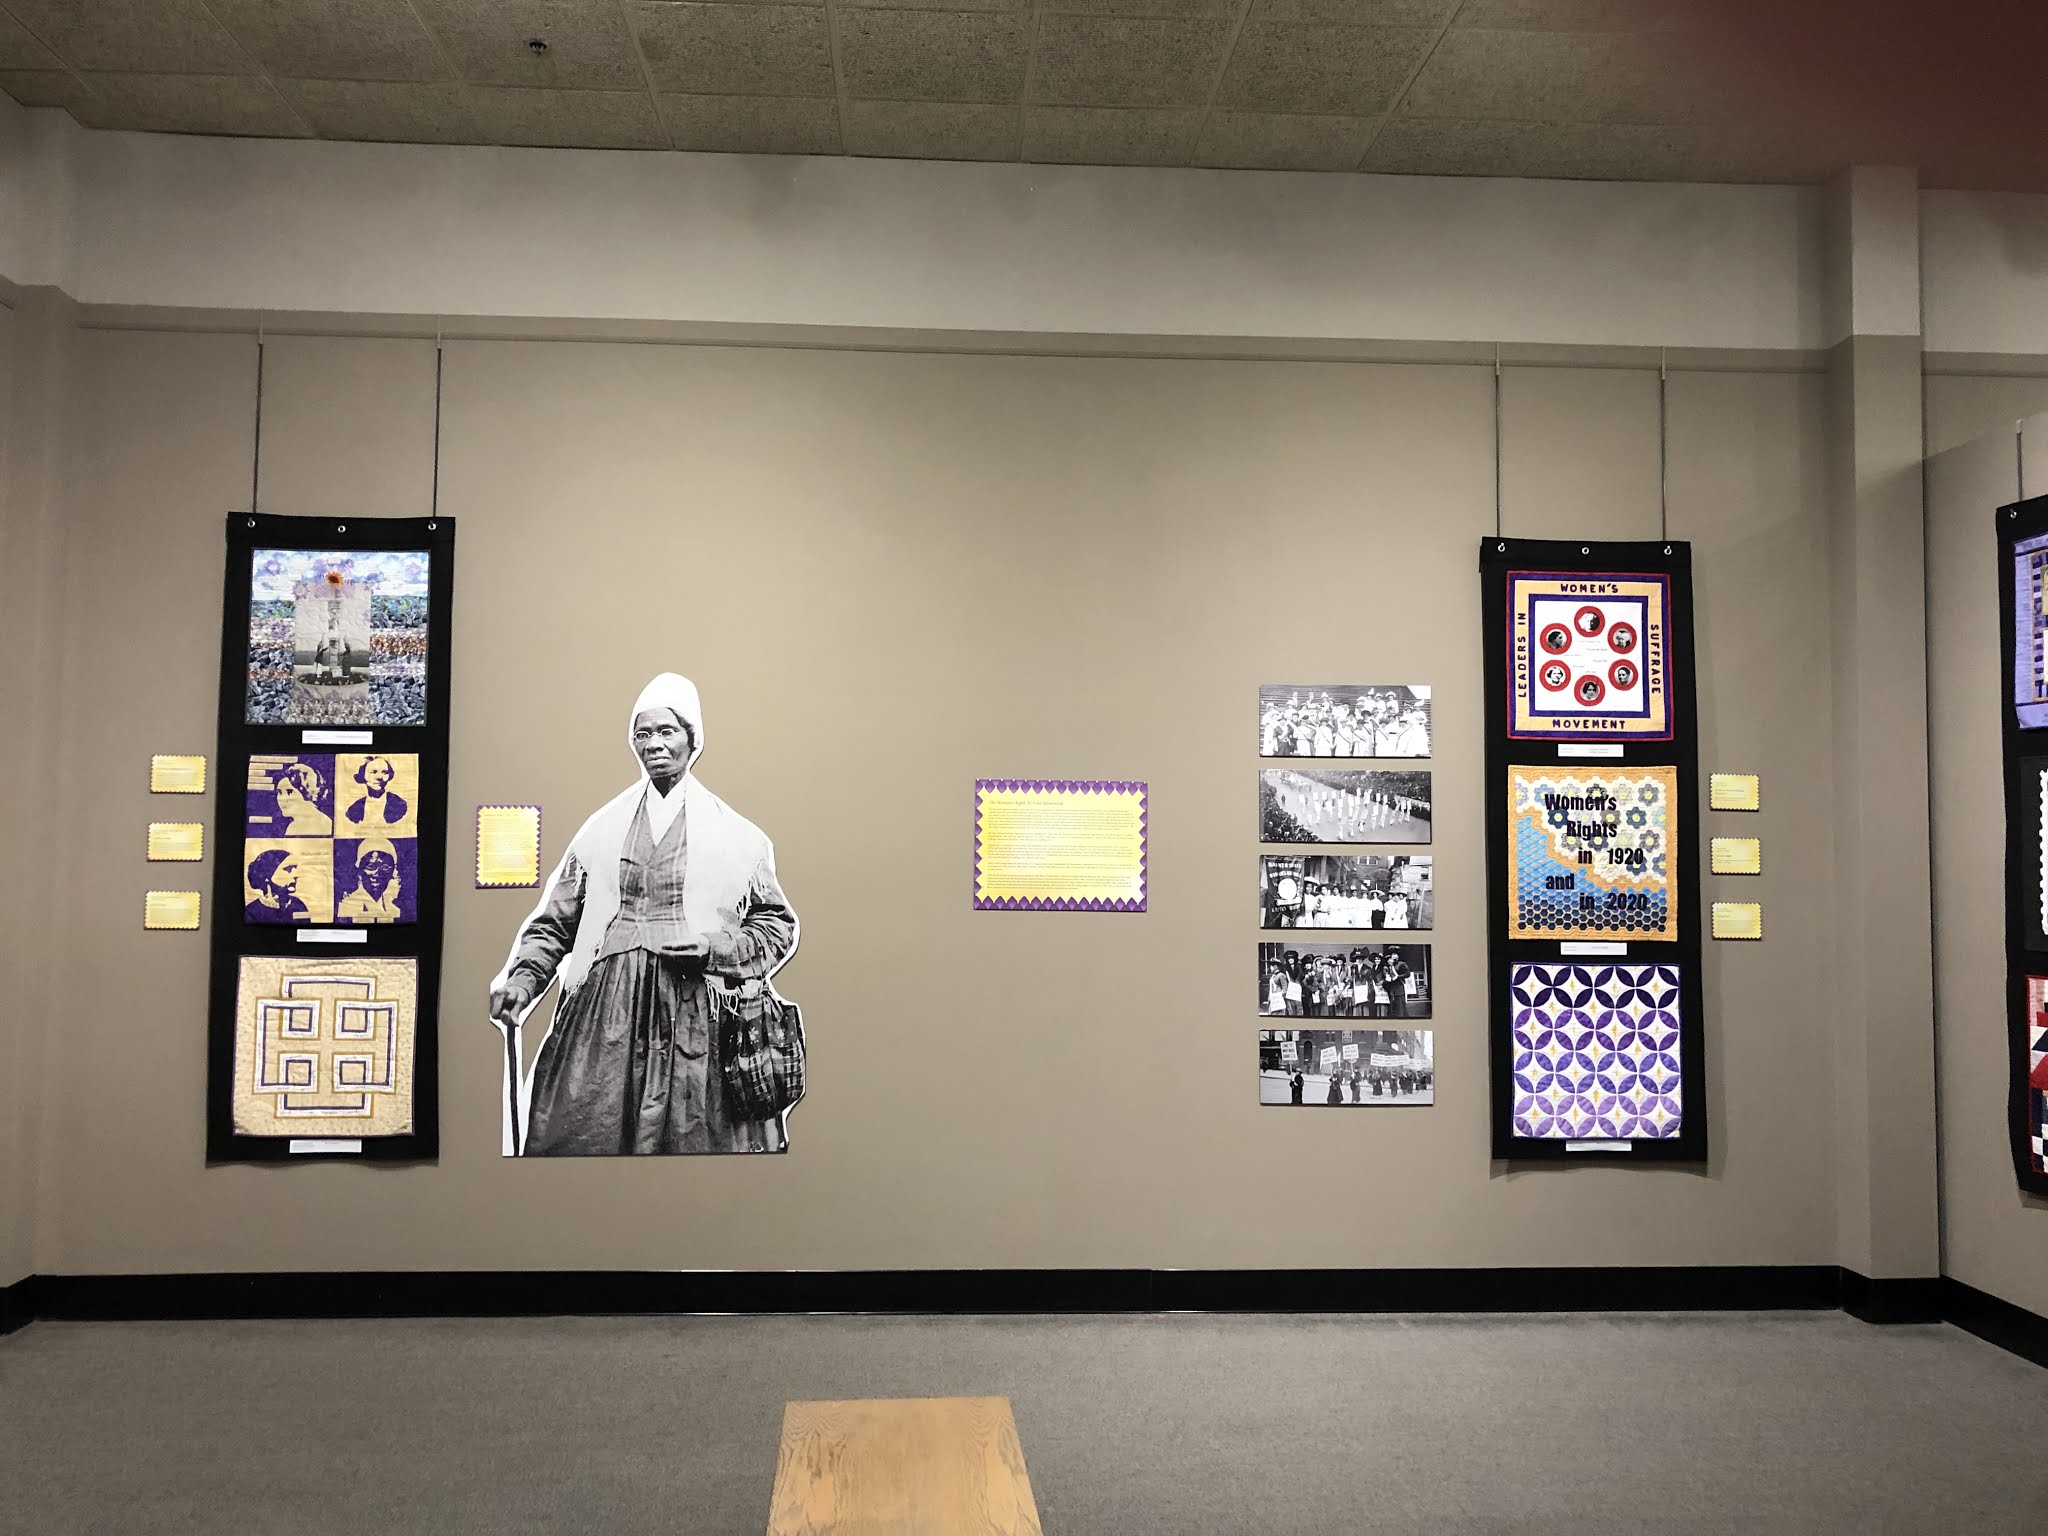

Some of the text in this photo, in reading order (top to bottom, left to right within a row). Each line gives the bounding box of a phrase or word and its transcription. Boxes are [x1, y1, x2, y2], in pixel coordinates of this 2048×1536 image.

[1561, 583, 1619, 594] WOMEN'S
[1517, 613, 1527, 698] LEADERS IN
[1650, 624, 1661, 694] SUFFRAGE
[1552, 719, 1626, 729] MOVEMENT
[1544, 794, 1617, 811] Women's
[1566, 821, 1618, 841] Rights
[1577, 847, 1644, 865] in 1920
[1545, 873, 1575, 890] and
[1579, 893, 1648, 911] in 2020
